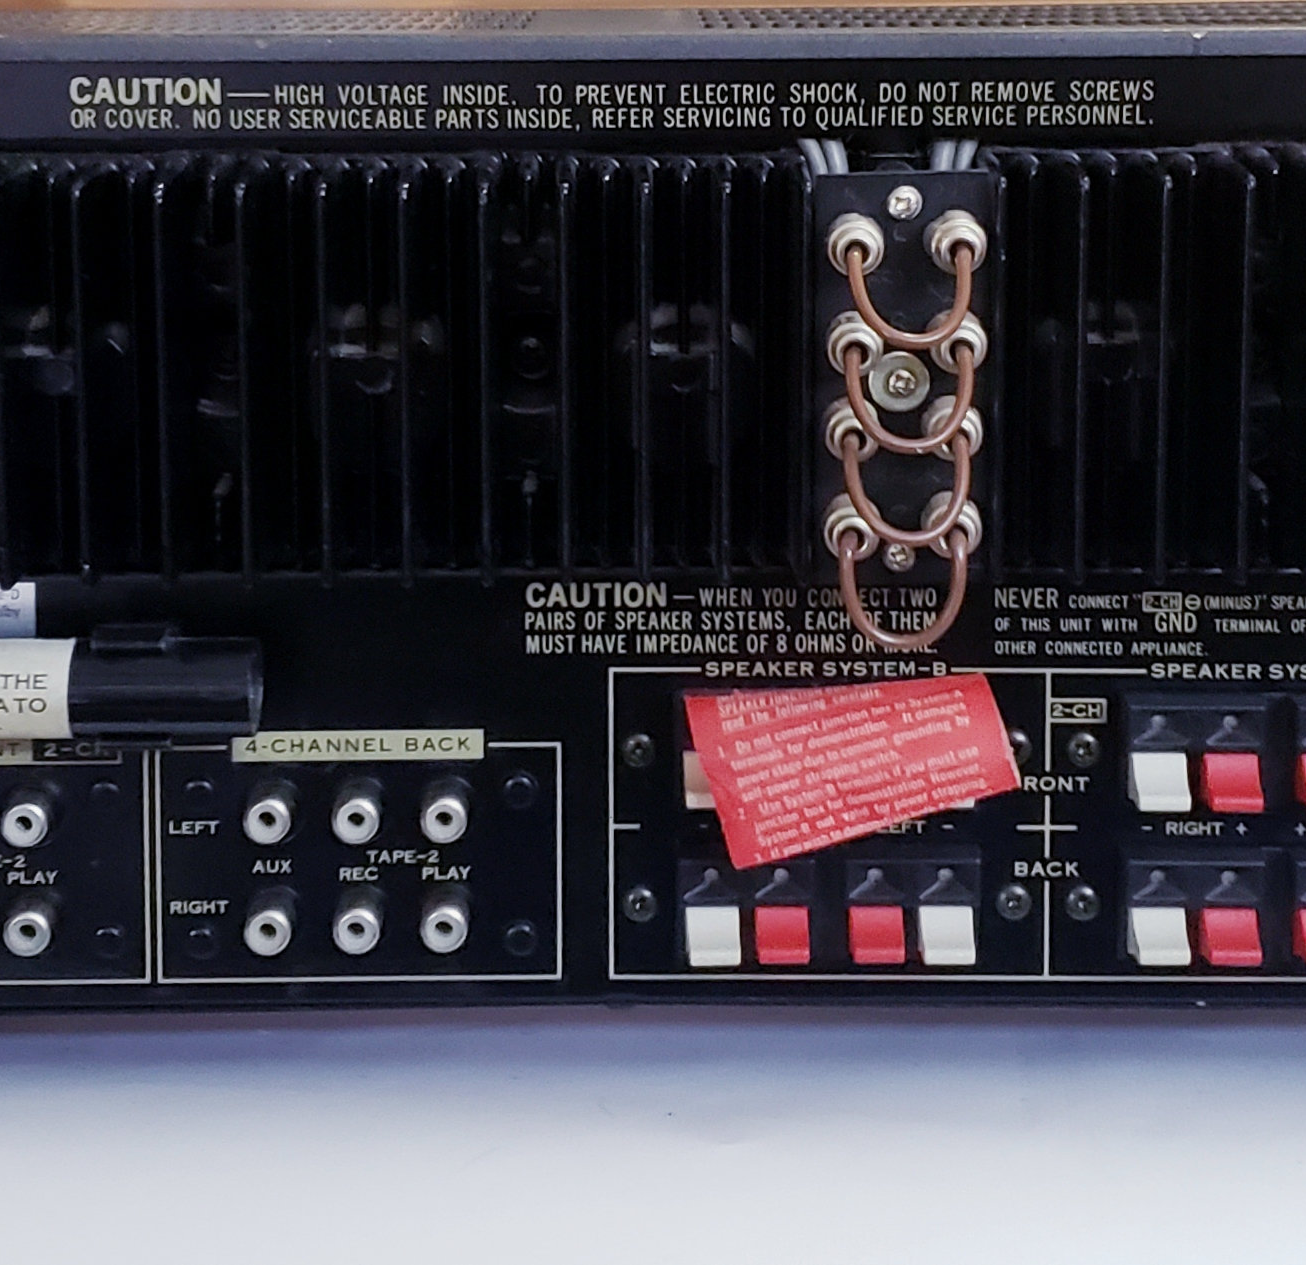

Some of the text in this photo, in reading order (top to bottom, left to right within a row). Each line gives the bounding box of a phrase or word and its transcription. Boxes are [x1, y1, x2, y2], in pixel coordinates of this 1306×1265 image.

[70, 77, 1154, 108] CAUTION HIGH VOLTAGE INSIDE. TO PREVENT ELECTRIC SHOCK, DO NOT REMOVE SCREWS
[70, 104, 1154, 132] OR COVER. NO USER SERVICEABLE PARTS INSIDE, REFER SERVICING TO QUALIFIED SERVICE PERSONNEL.
[526, 582, 937, 608] CAUTION WHEN YOU CONECT TWO
[994, 588, 1059, 609] NEVER
[1068, 595, 1129, 609] CONNECT
[524, 611, 937, 633] PAIRS OF SPEAKER SYSTEMS, EACH THEM
[1021, 617, 1051, 632] THIS
[1060, 617, 1092, 632] UNIT
[1102, 617, 1138, 632] WITH
[1154, 612, 1198, 633] GND
[1214, 618, 1281, 633] TERMINAL
[525, 634, 846, 654] MUST HAVE IMPEDANCE OF 8 OHMS
[994, 640, 1209, 657] OTHER CONNECTED APPLIANCE.
[704, 661, 948, 677] SPEAKER SYSTEM-B
[1150, 663, 1262, 680] SPEAKER
[0, 673, 48, 691] THE
[14, 698, 48, 714] TO
[1051, 704, 1103, 718] 2-CH
[245, 736, 471, 754] 4-CHANNEL BACK
[1023, 776, 1090, 792] RONT
[168, 819, 220, 835] LEFT
[1164, 821, 1225, 836] RIGHT
[252, 849, 440, 875] AUX TAPE-2
[1013, 861, 1081, 879] BACK
[7, 871, 59, 886] PLAY
[339, 866, 472, 882] REC PLAY
[169, 900, 230, 916] RIGHT
